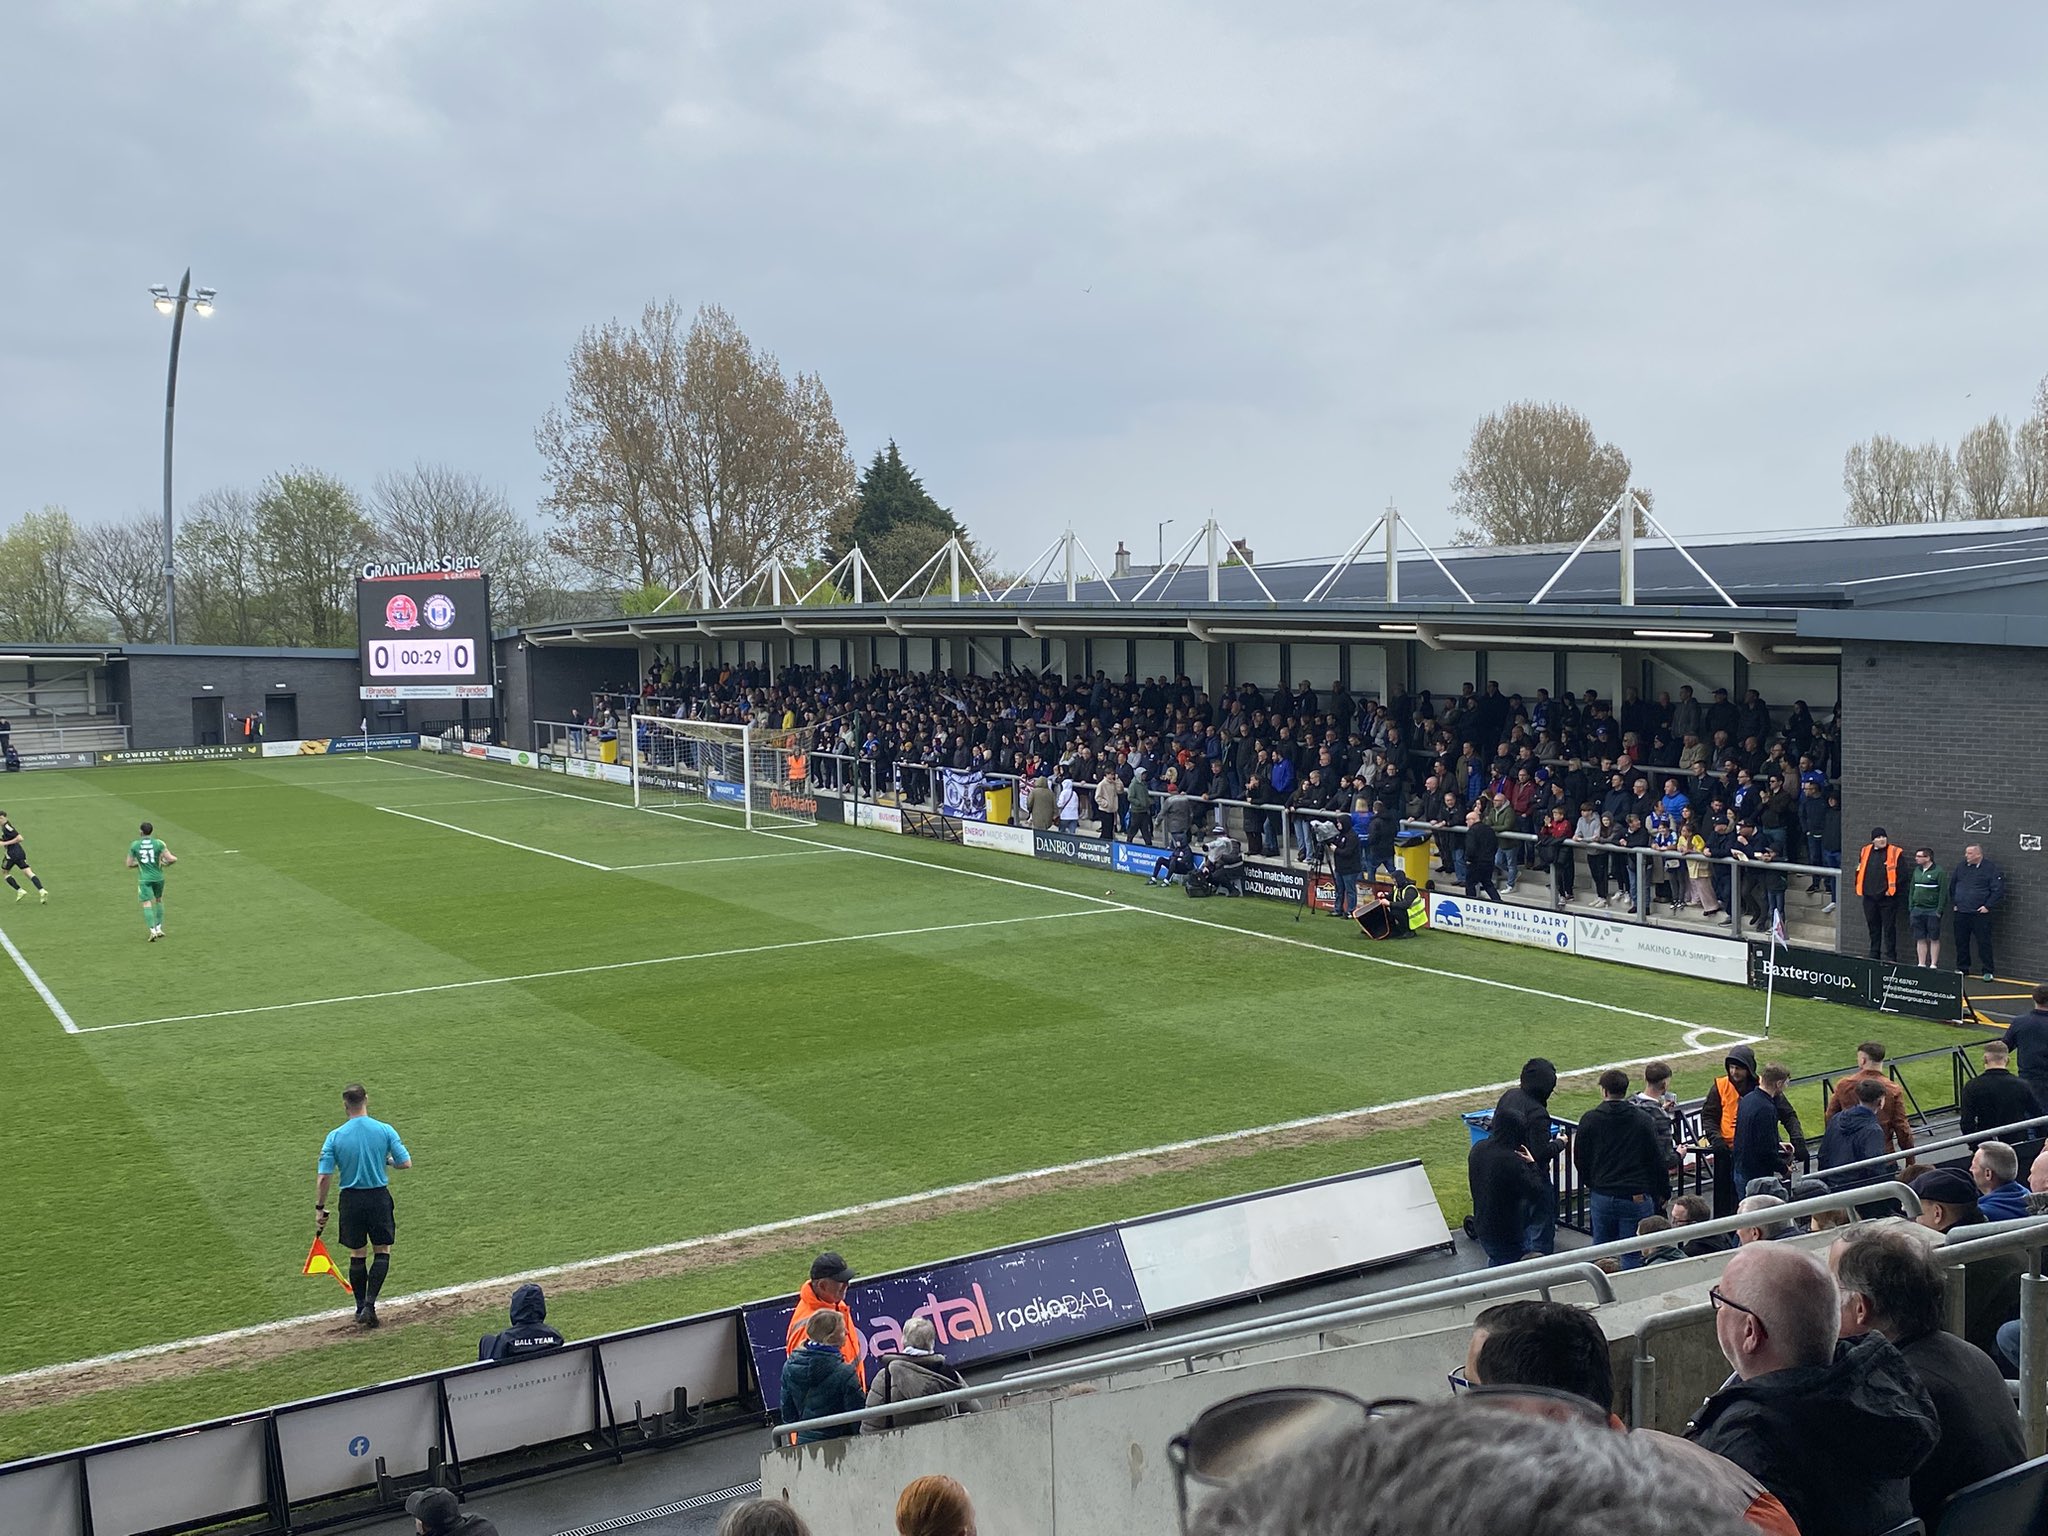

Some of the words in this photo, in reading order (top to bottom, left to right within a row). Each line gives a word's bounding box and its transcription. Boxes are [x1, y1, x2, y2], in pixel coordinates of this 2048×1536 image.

[363, 558, 440, 579] GRANTHAMS
[441, 554, 480, 572] Signs
[451, 570, 480, 579] GRAPHICS
[374, 645, 389, 669] 0
[401, 650, 442, 665] 00:29
[454, 645, 468, 669] 0
[117, 750, 170, 758] MOWBRECK
[174, 747, 215, 756] HOLIDAY
[964, 826, 985, 837] ENERGY
[1004, 832, 1025, 844] SIMPLE
[1036, 836, 1075, 857] DANBRO
[139, 849, 155, 864] 31
[1077, 851, 1087, 860] FOR
[1087, 853, 1100, 862] YOUR
[1101, 855, 1111, 864] LIFE
[1263, 870, 1293, 884] matches
[1294, 876, 1304, 886] on
[1244, 880, 1302, 900] DAZN.com/NLTV
[1316, 887, 1336, 899] RUSTLE
[1465, 903, 1499, 917] DERBY
[1503, 909, 1528, 922] HILL
[1533, 914, 1569, 928] DAIRY
[1465, 916, 1552, 936] www.derbyhilldairy.co.uk
[1637, 941, 1671, 956] MAKING
[1672, 947, 1687, 958] TAX
[1689, 951, 1717, 963] SIMPLE
[514, 1338, 533, 1347] BALL
[533, 1336, 554, 1345] TEAM
[452, 1392, 479, 1403] FRUIT
[484, 1387, 502, 1396] AND
[507, 1375, 558, 1391] VEGETABLE
